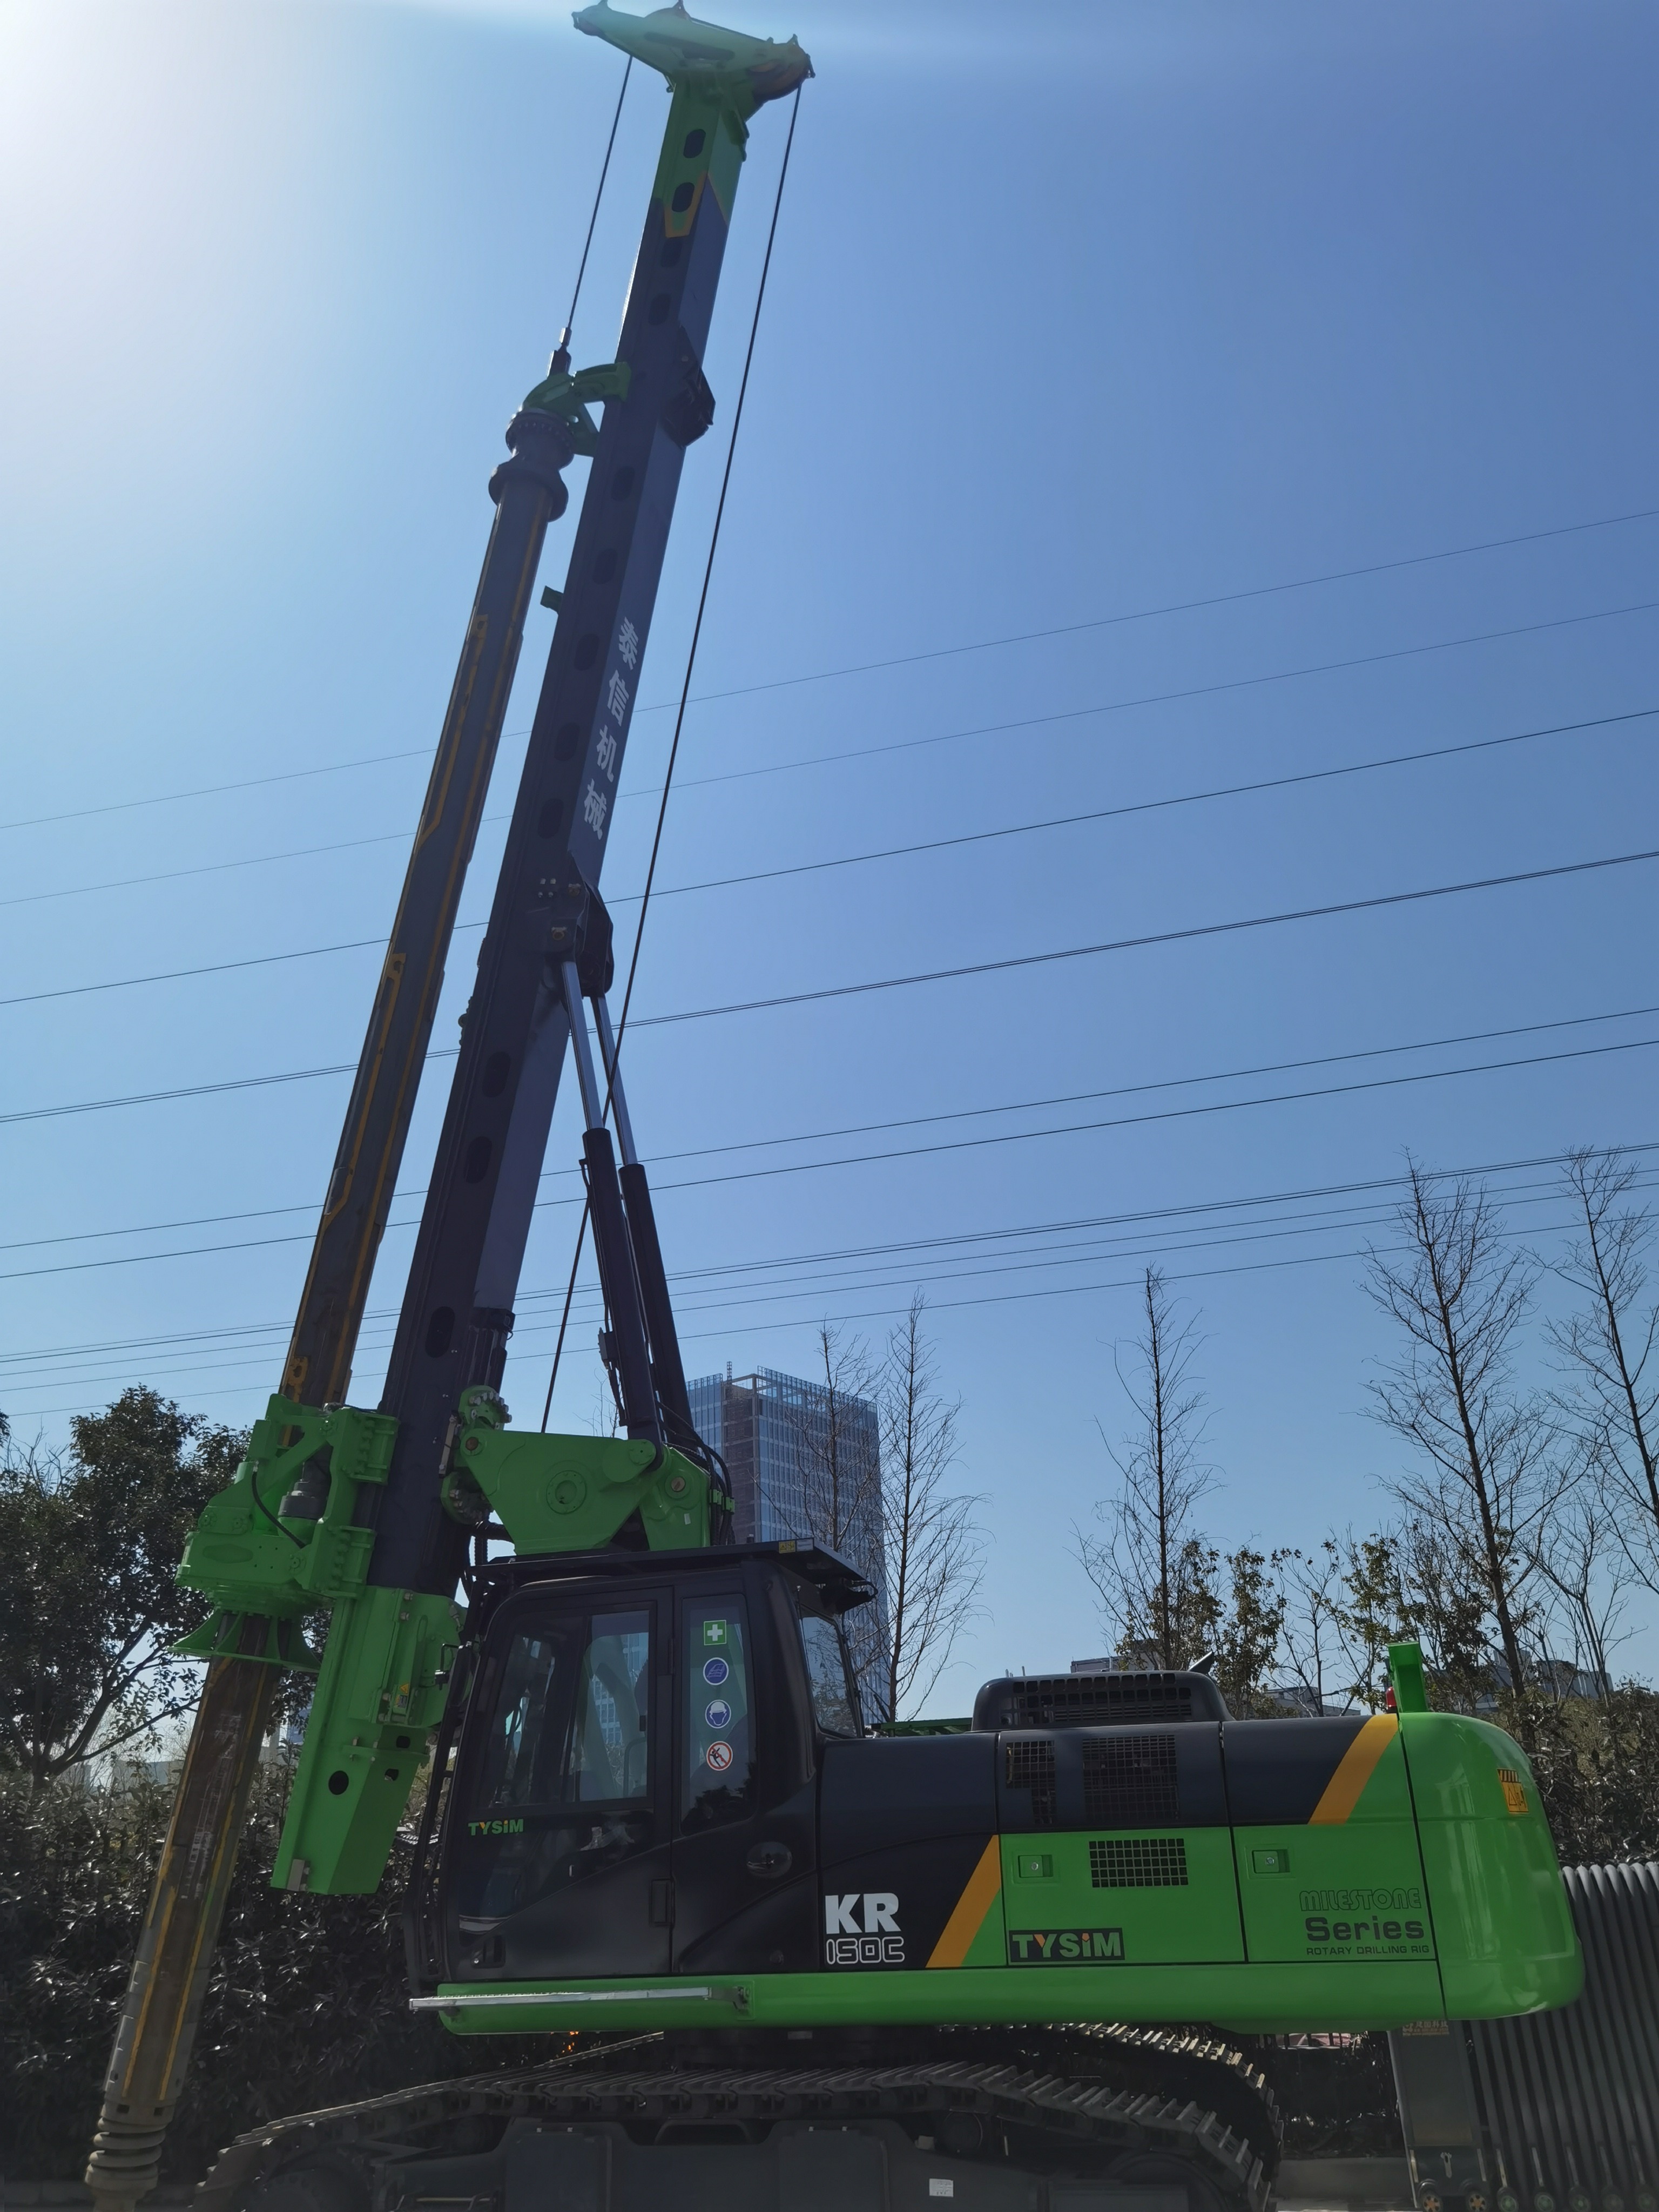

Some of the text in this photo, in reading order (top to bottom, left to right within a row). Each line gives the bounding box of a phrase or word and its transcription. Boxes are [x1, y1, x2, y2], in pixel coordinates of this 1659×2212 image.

[584, 616, 639, 840] 泰信机械
[1299, 1888, 1422, 1912] MILESTONE
[825, 1892, 902, 1935] KR
[1305, 1916, 1425, 1941] Series
[1306, 1945, 1429, 1955] ROTARY DRILLING RIG
